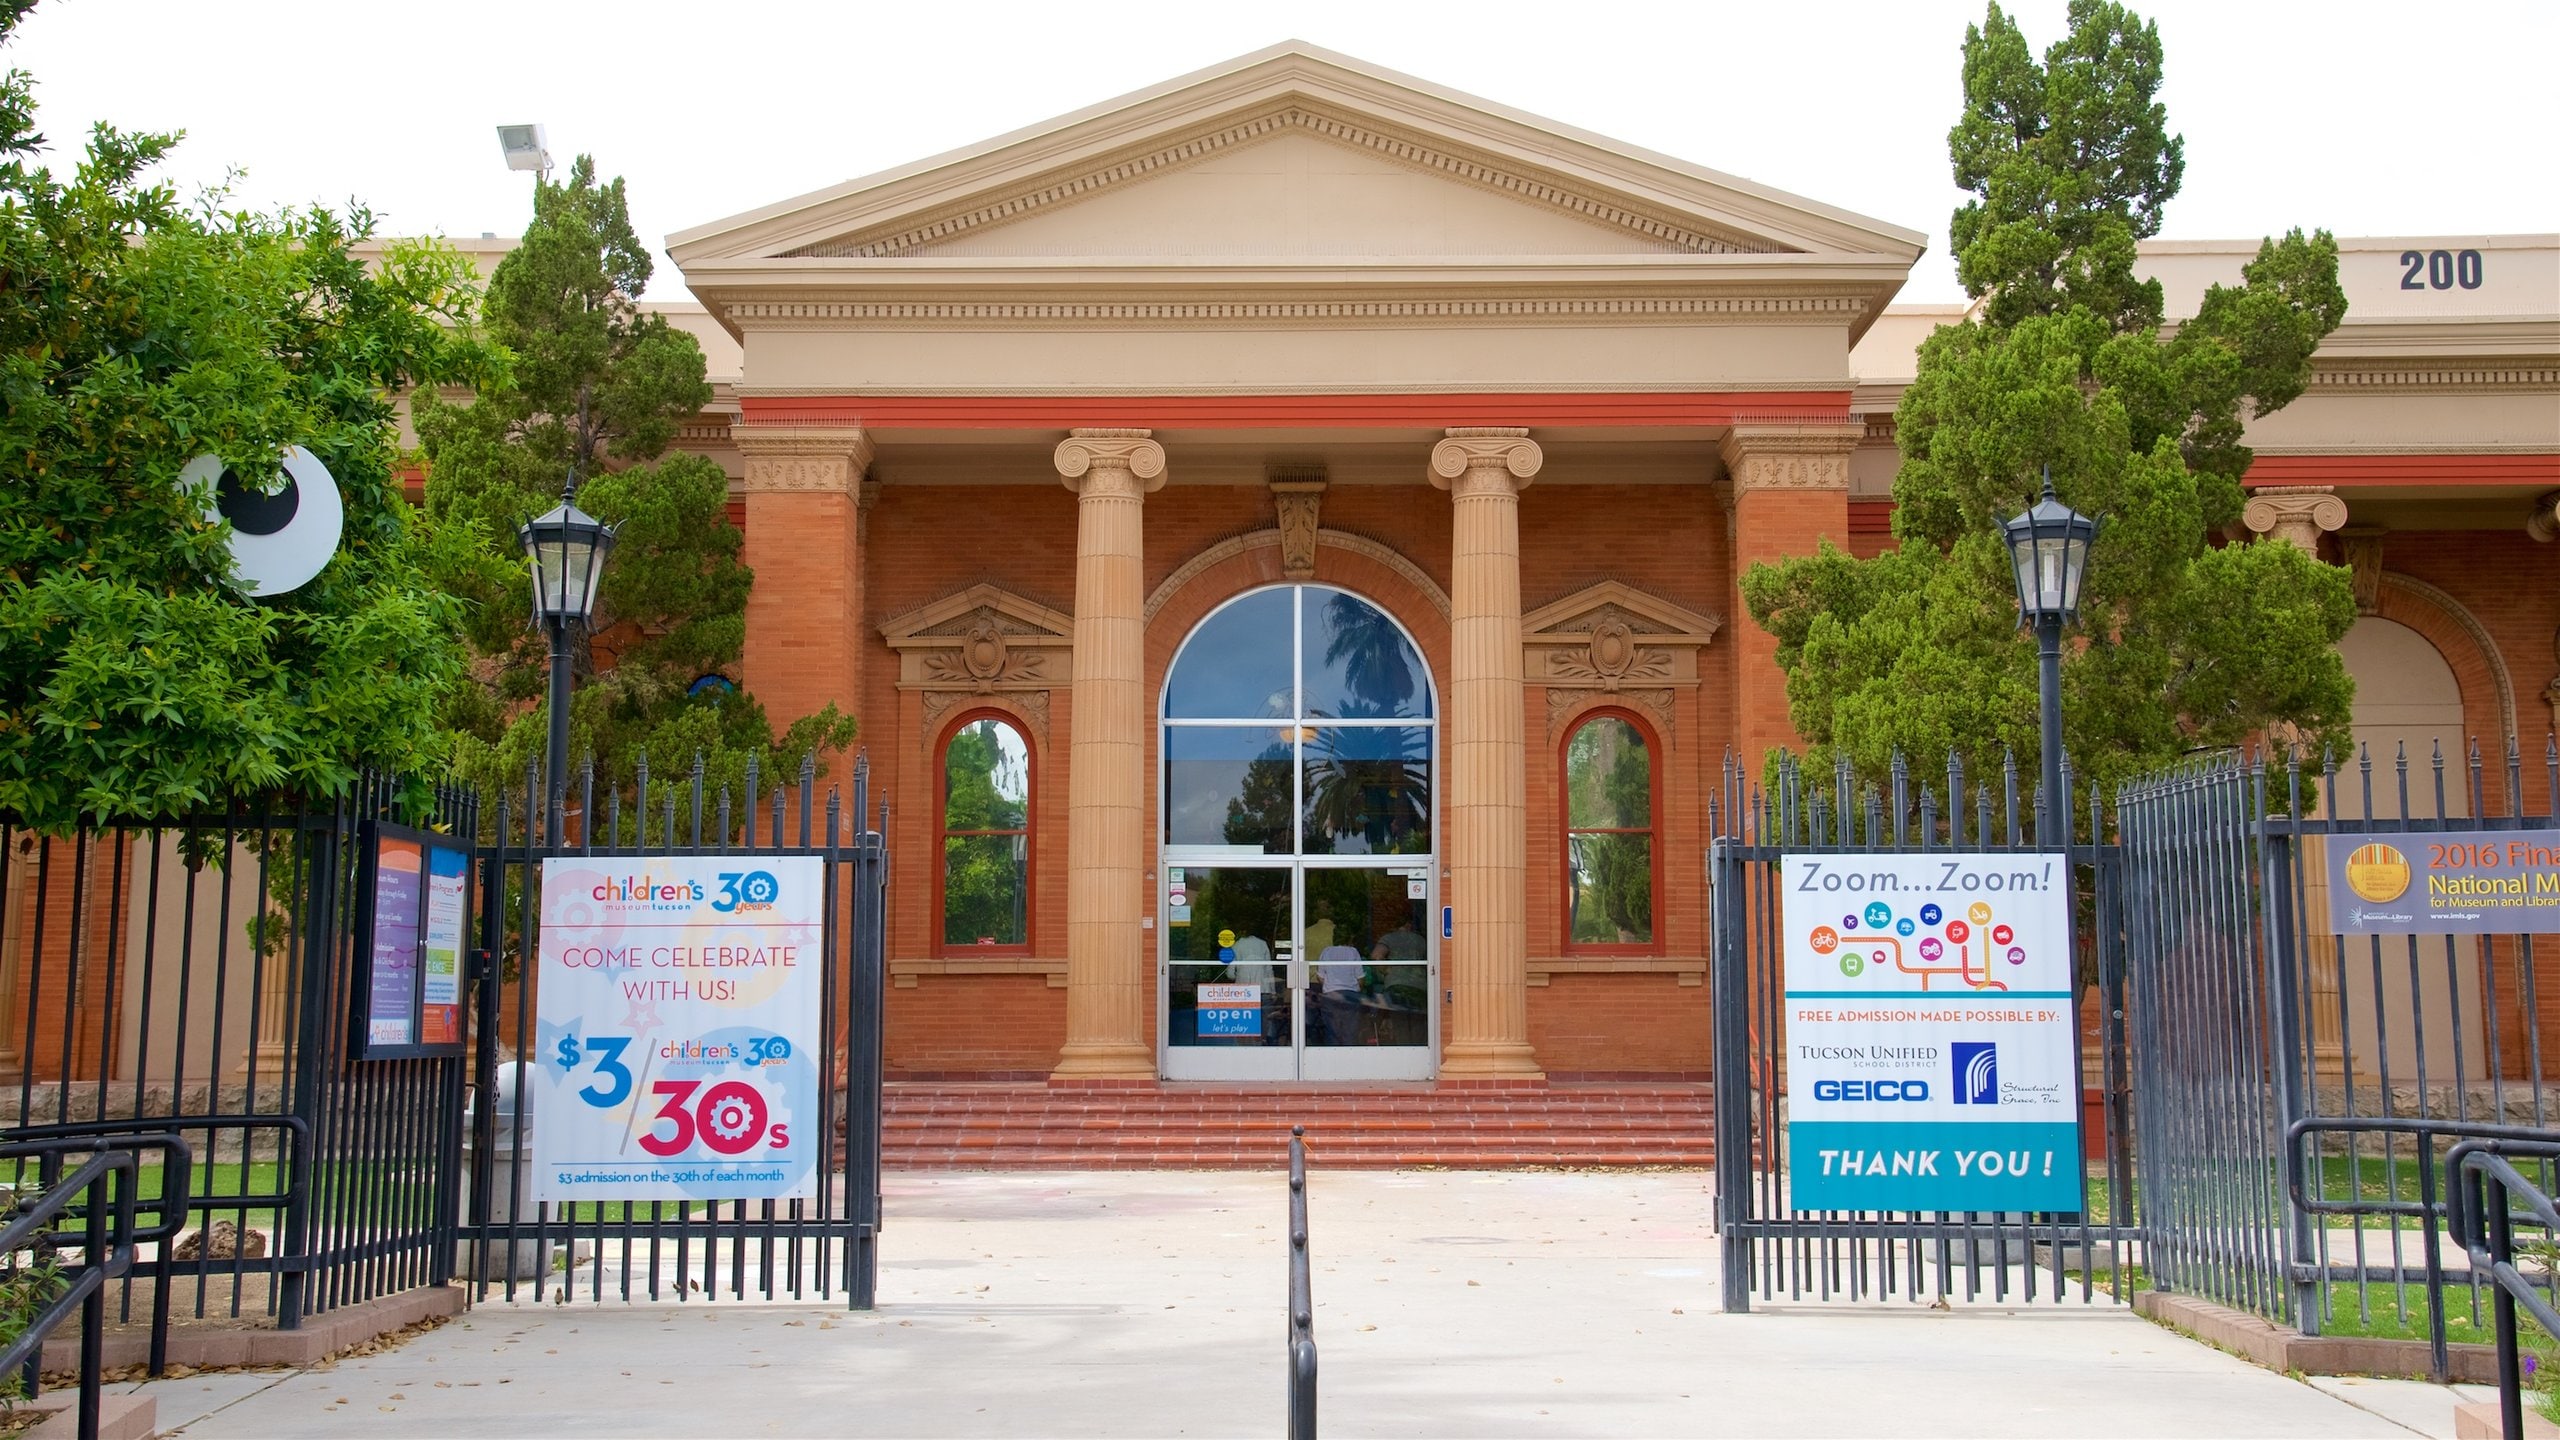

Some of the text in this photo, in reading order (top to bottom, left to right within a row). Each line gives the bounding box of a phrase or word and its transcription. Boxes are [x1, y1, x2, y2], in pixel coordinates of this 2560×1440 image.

[2400, 249, 2483, 290] 200
[2428, 843, 2499, 869] 2016
[711, 870, 779, 913] 30
[2428, 872, 2529, 895] National
[734, 902, 772, 915] years
[2430, 897, 2446, 907] for
[2449, 897, 2499, 908] Museum
[2501, 896, 2523, 907] and
[2430, 912, 2480, 920] www.imls.gov
[563, 947, 797, 968] COME CELEBRATE
[623, 980, 736, 1000] WITH US!
[1207, 1009, 1252, 1023] open
[1799, 1011, 2060, 1022] FREE ADMISSION MADE POSSIBLE BY:
[1212, 1024, 1249, 1034] let's play
[743, 1036, 791, 1066] 30
[1814, 1080, 1930, 1102] GEICO
[2000, 1082, 2059, 1093] Structural
[1818, 1150, 1941, 1177] THANK
[558, 1169, 785, 1184] $3 admission on the 30th of each month
